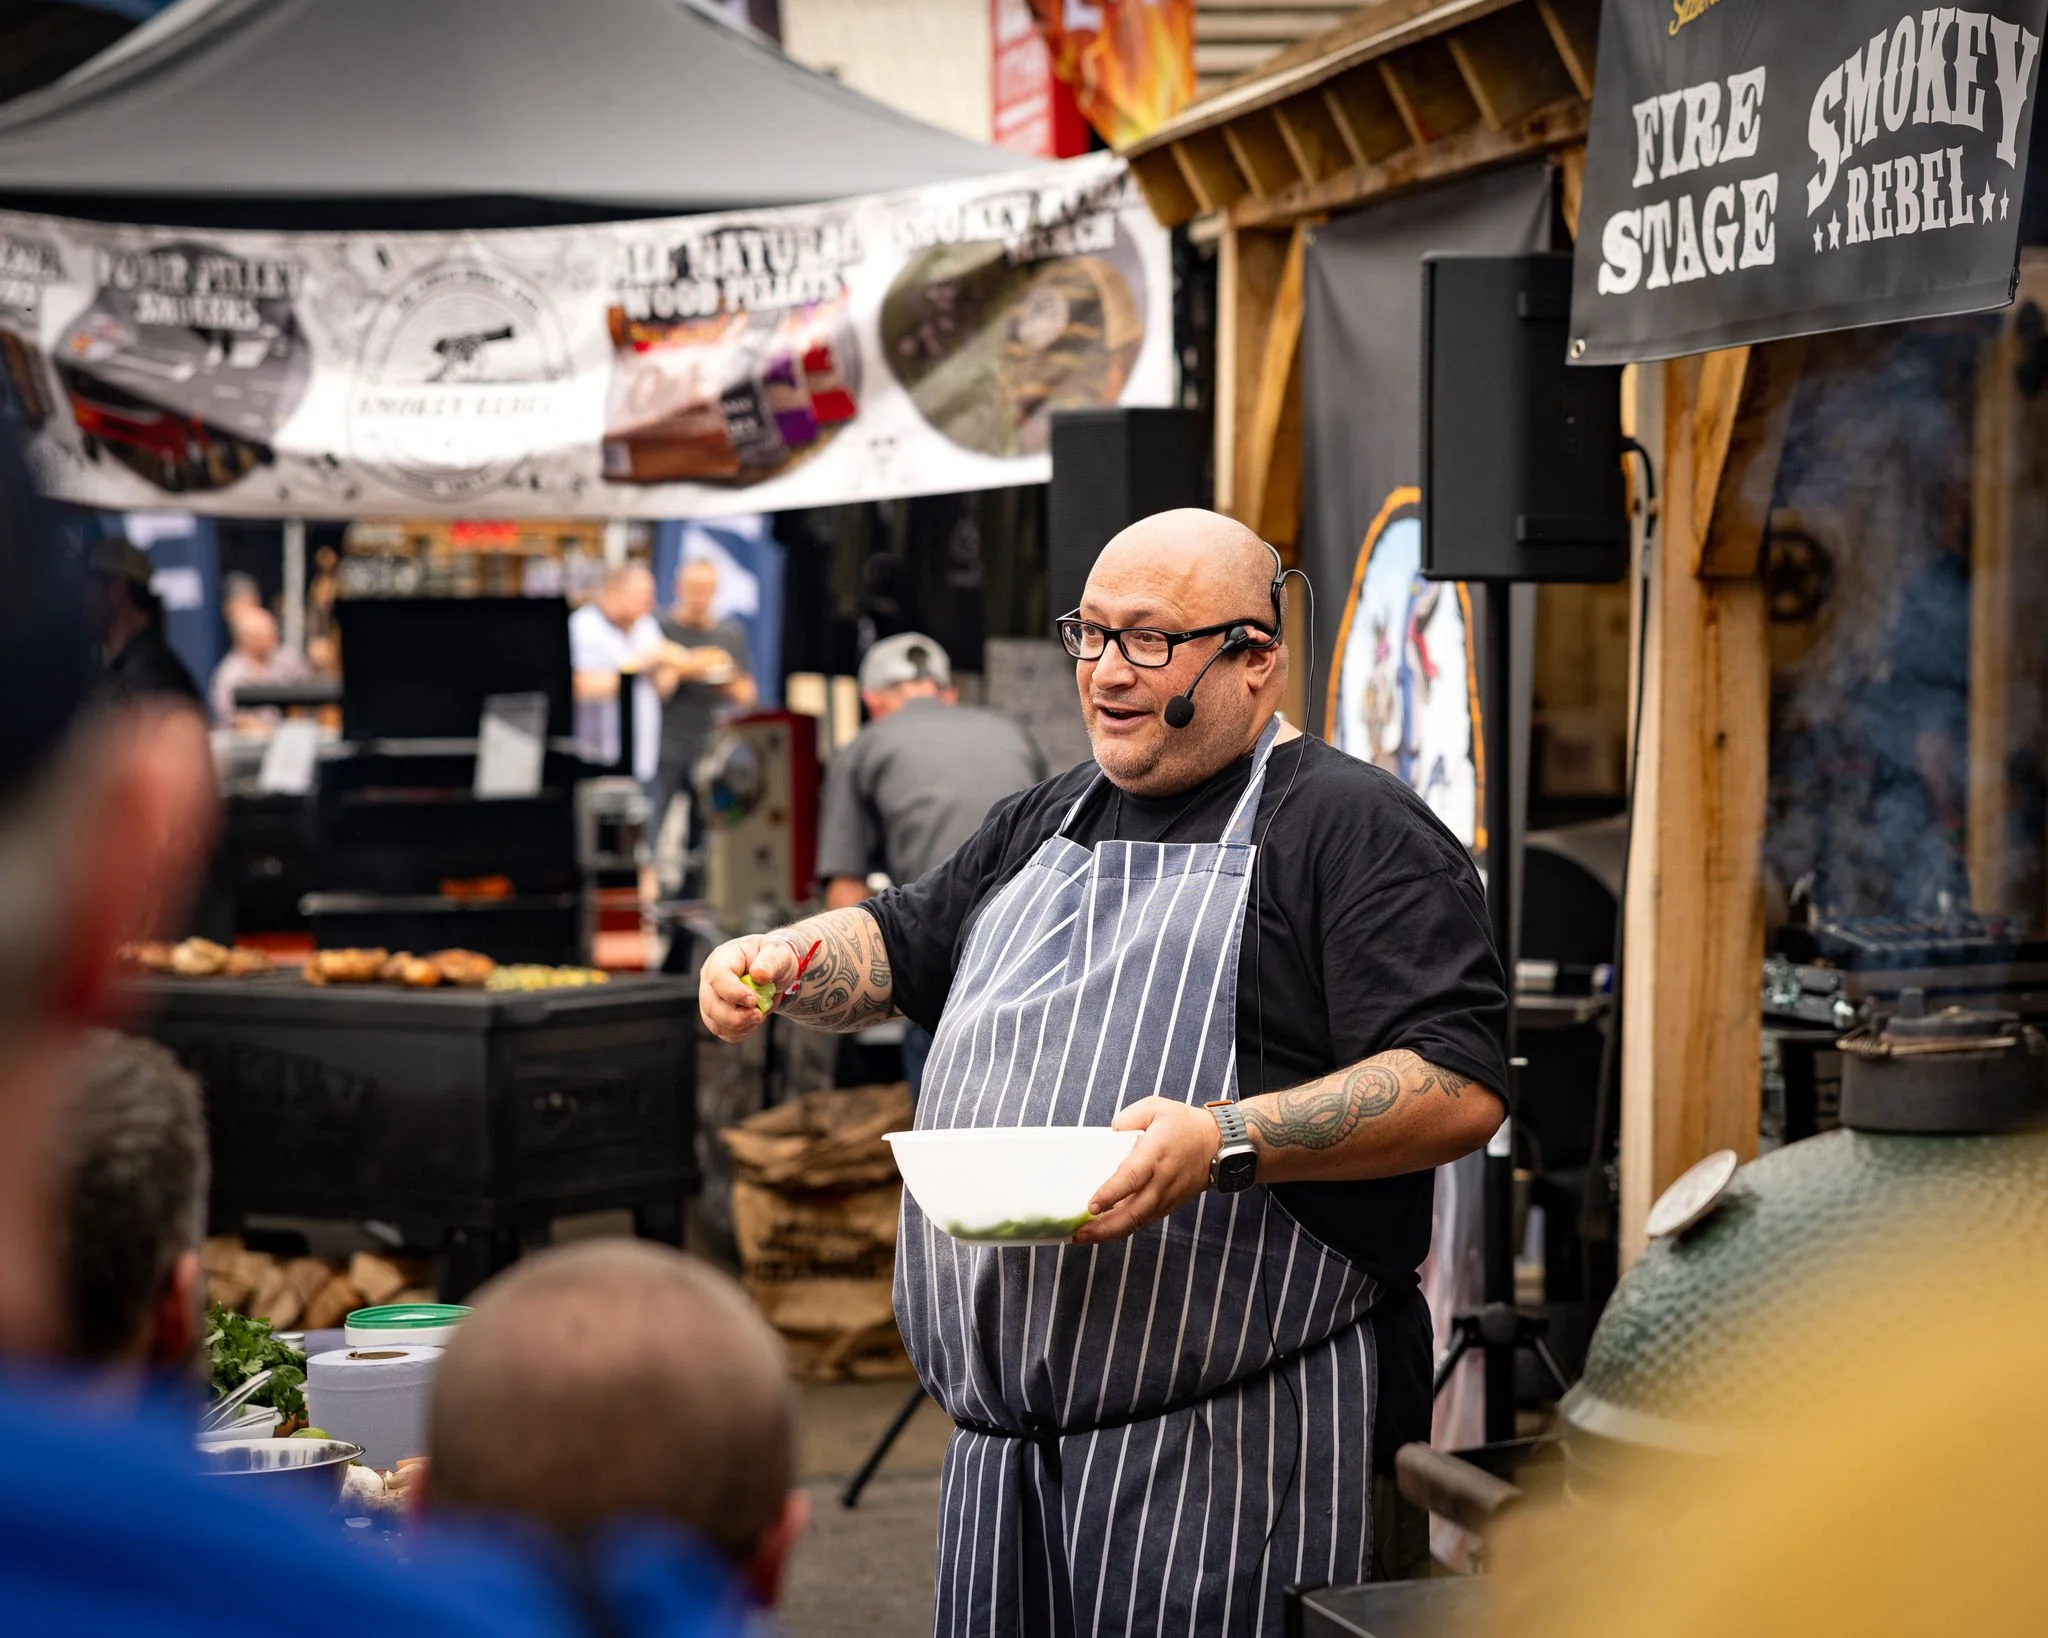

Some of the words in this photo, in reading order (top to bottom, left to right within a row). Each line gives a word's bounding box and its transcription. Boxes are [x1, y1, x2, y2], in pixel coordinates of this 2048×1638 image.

[1632, 66, 1766, 188] FIRE
[1807, 7, 2039, 217] SMOKEY
[1597, 173, 1779, 296] STAGE
[1846, 145, 1974, 246] REBEL
